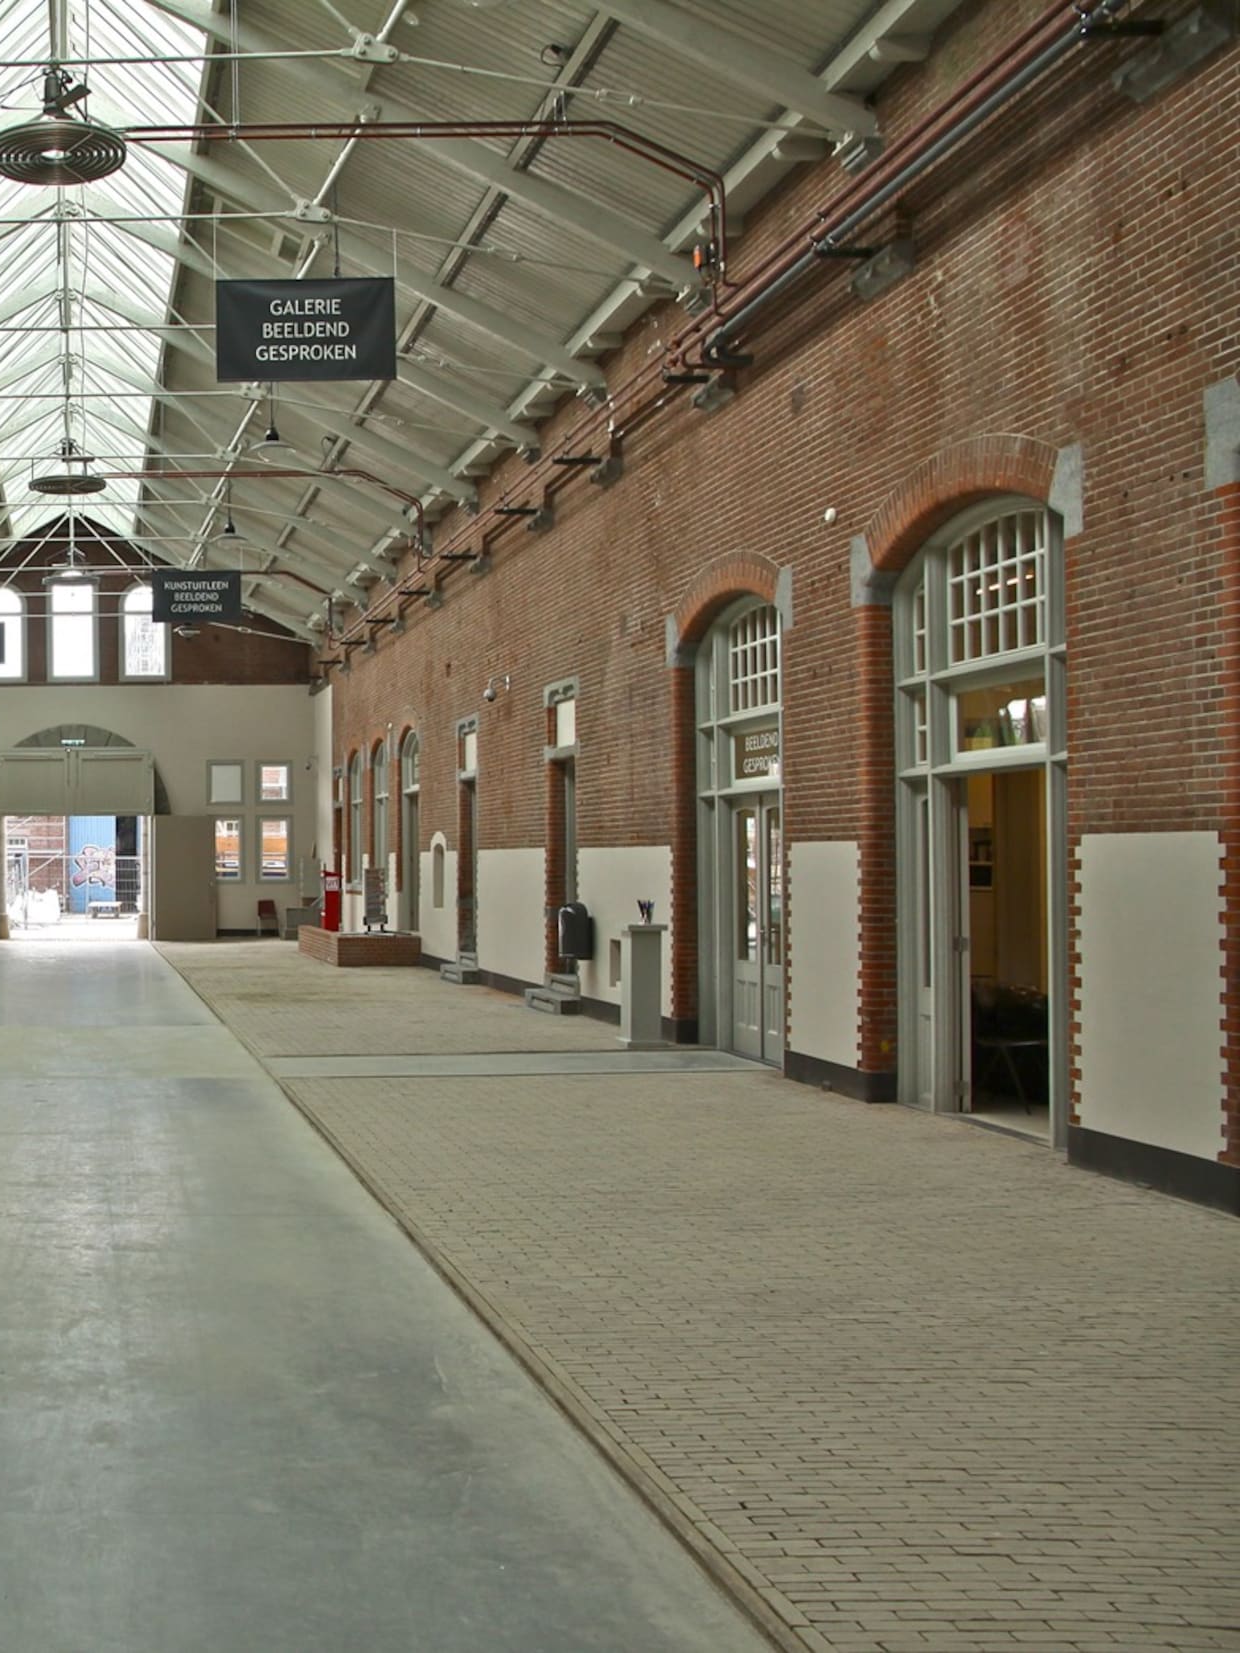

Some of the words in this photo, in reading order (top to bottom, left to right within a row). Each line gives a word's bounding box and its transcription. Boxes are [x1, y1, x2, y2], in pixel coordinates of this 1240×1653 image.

[269, 299, 341, 316] GALERIE
[262, 322, 350, 339] BEELDEND
[255, 344, 357, 361] GESPROKEN
[164, 581, 229, 590] KUNSTUITLEEN
[174, 592, 219, 601] BEELDEND
[170, 603, 222, 613] GESPROKEN
[744, 731, 778, 752] BEELDEND
